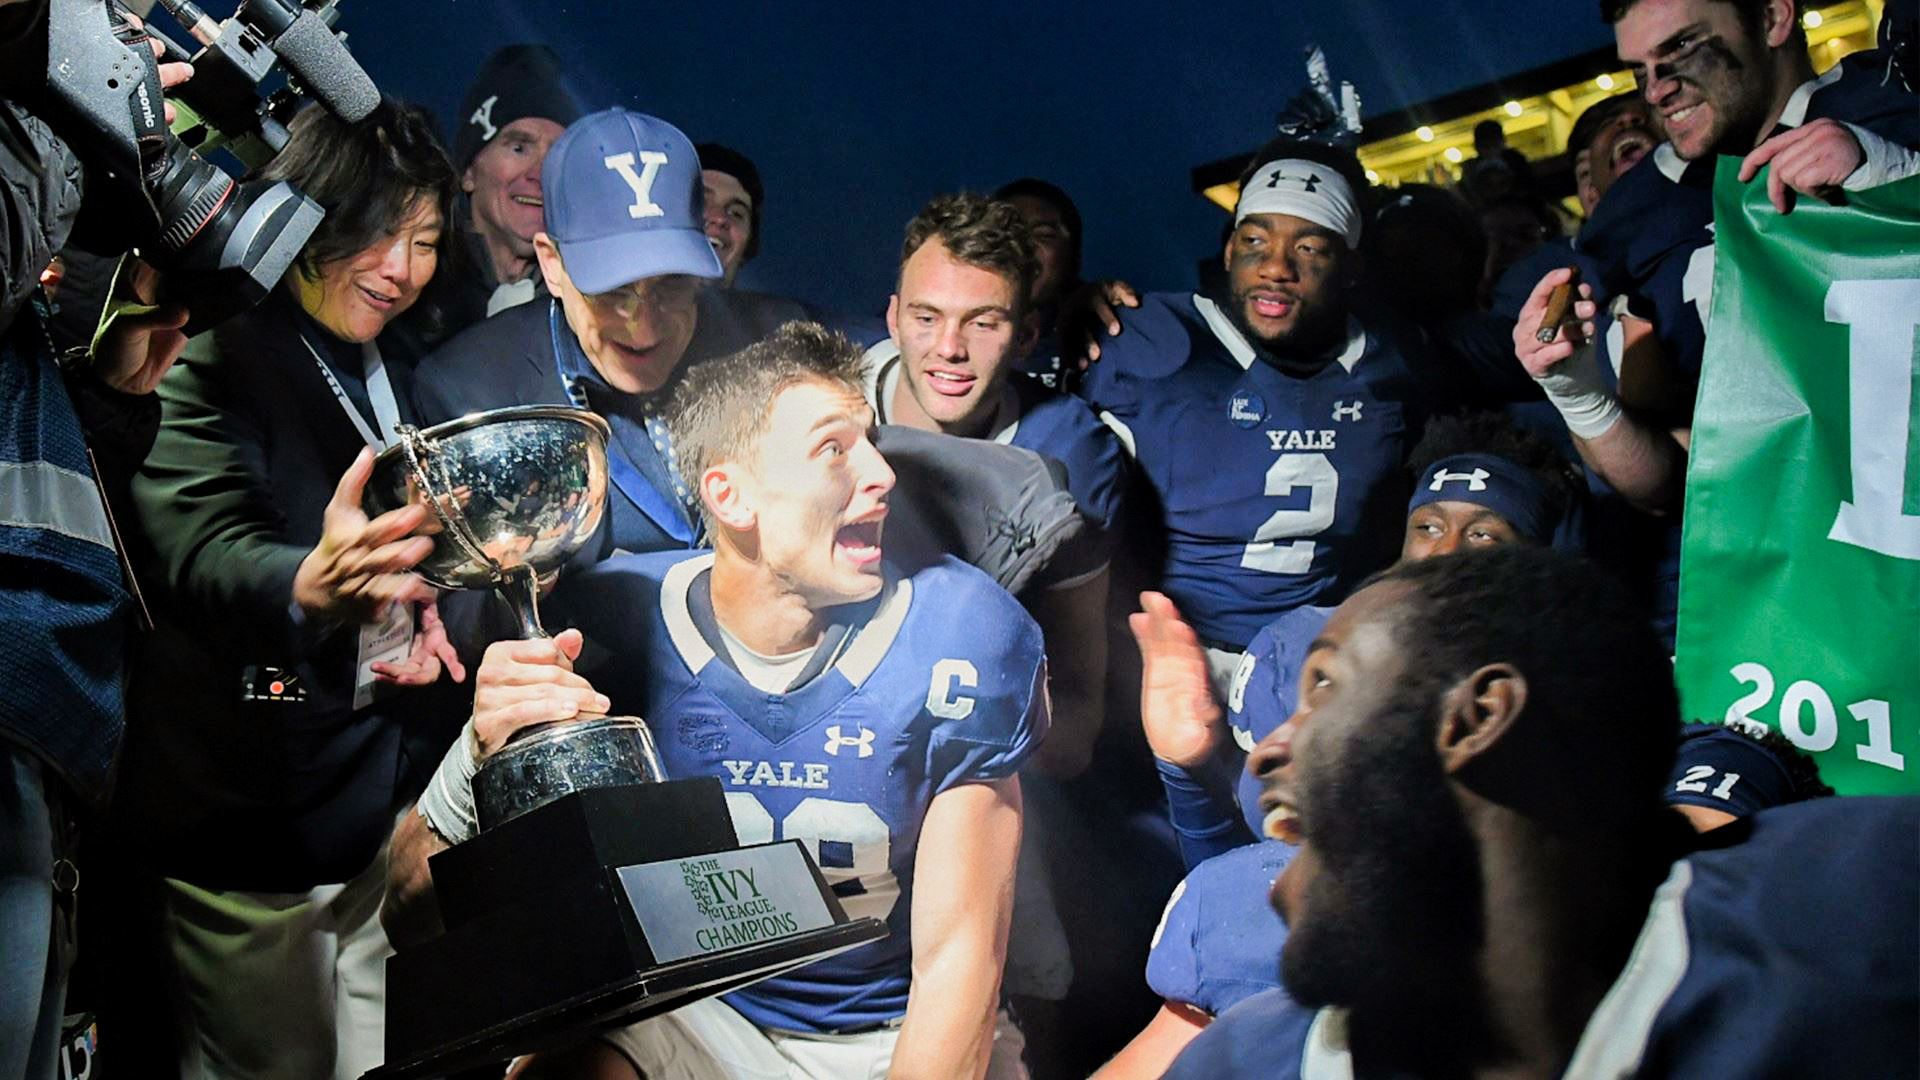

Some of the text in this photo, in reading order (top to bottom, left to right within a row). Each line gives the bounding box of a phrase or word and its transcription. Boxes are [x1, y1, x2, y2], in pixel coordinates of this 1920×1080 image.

[470, 95, 498, 141] Y
[604, 151, 668, 219] Y
[1266, 430, 1336, 450] YALE
[1240, 453, 1339, 574] 2
[925, 658, 978, 720] C
[1724, 662, 1920, 771] 201
[722, 760, 829, 789] YALE
[1676, 765, 1740, 800] 21
[699, 858, 721, 874] THE
[704, 867, 762, 904] IVY
[695, 911, 798, 951] CHAMPIONS
